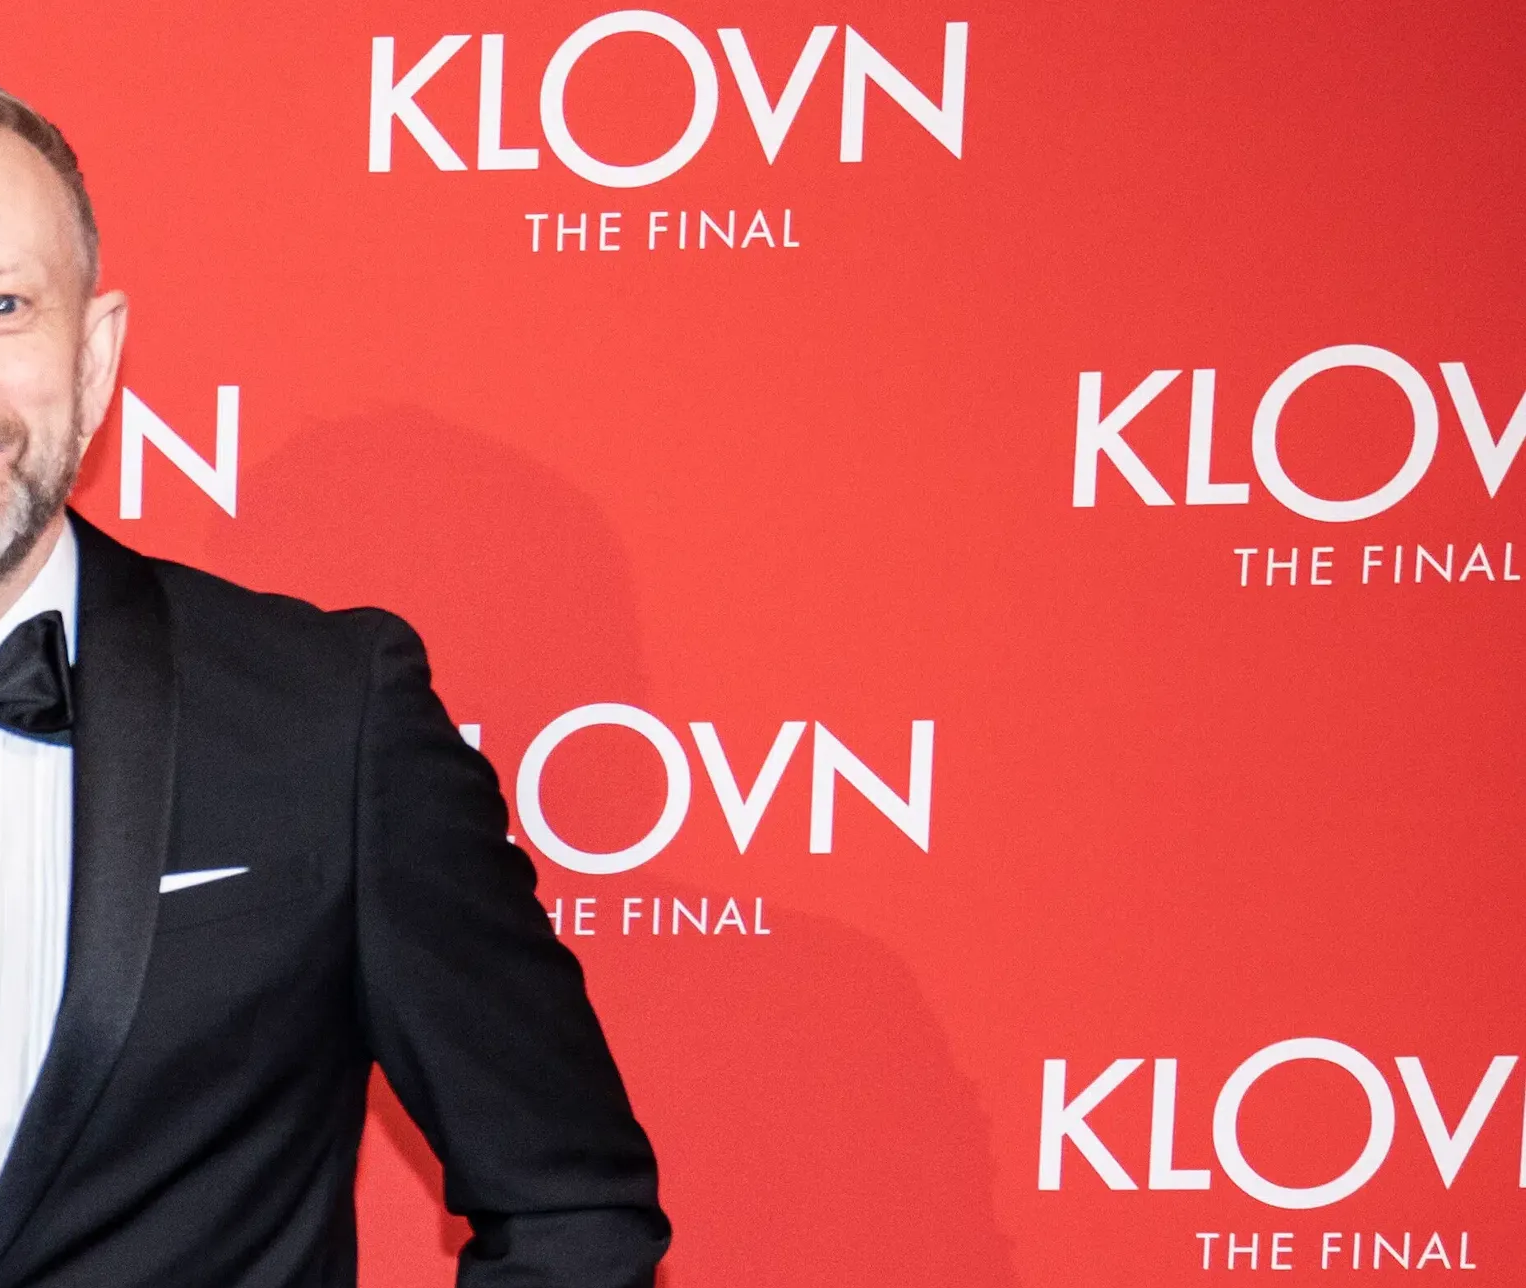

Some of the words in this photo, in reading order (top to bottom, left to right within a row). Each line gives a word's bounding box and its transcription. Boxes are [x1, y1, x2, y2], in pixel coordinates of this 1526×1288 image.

[368, 9, 968, 189] KLOVN
[525, 212, 619, 253] THE
[648, 208, 800, 251] FINAL
[1073, 343, 1526, 523] KLOV
[1234, 546, 1335, 588] THE
[1362, 542, 1521, 586] FINAL
[459, 702, 934, 875] OVN
[622, 896, 771, 936] FINAL
[1038, 1036, 1526, 1210] KLOV
[1196, 1232, 1295, 1271] THE
[1321, 1231, 1477, 1270] FINAL
